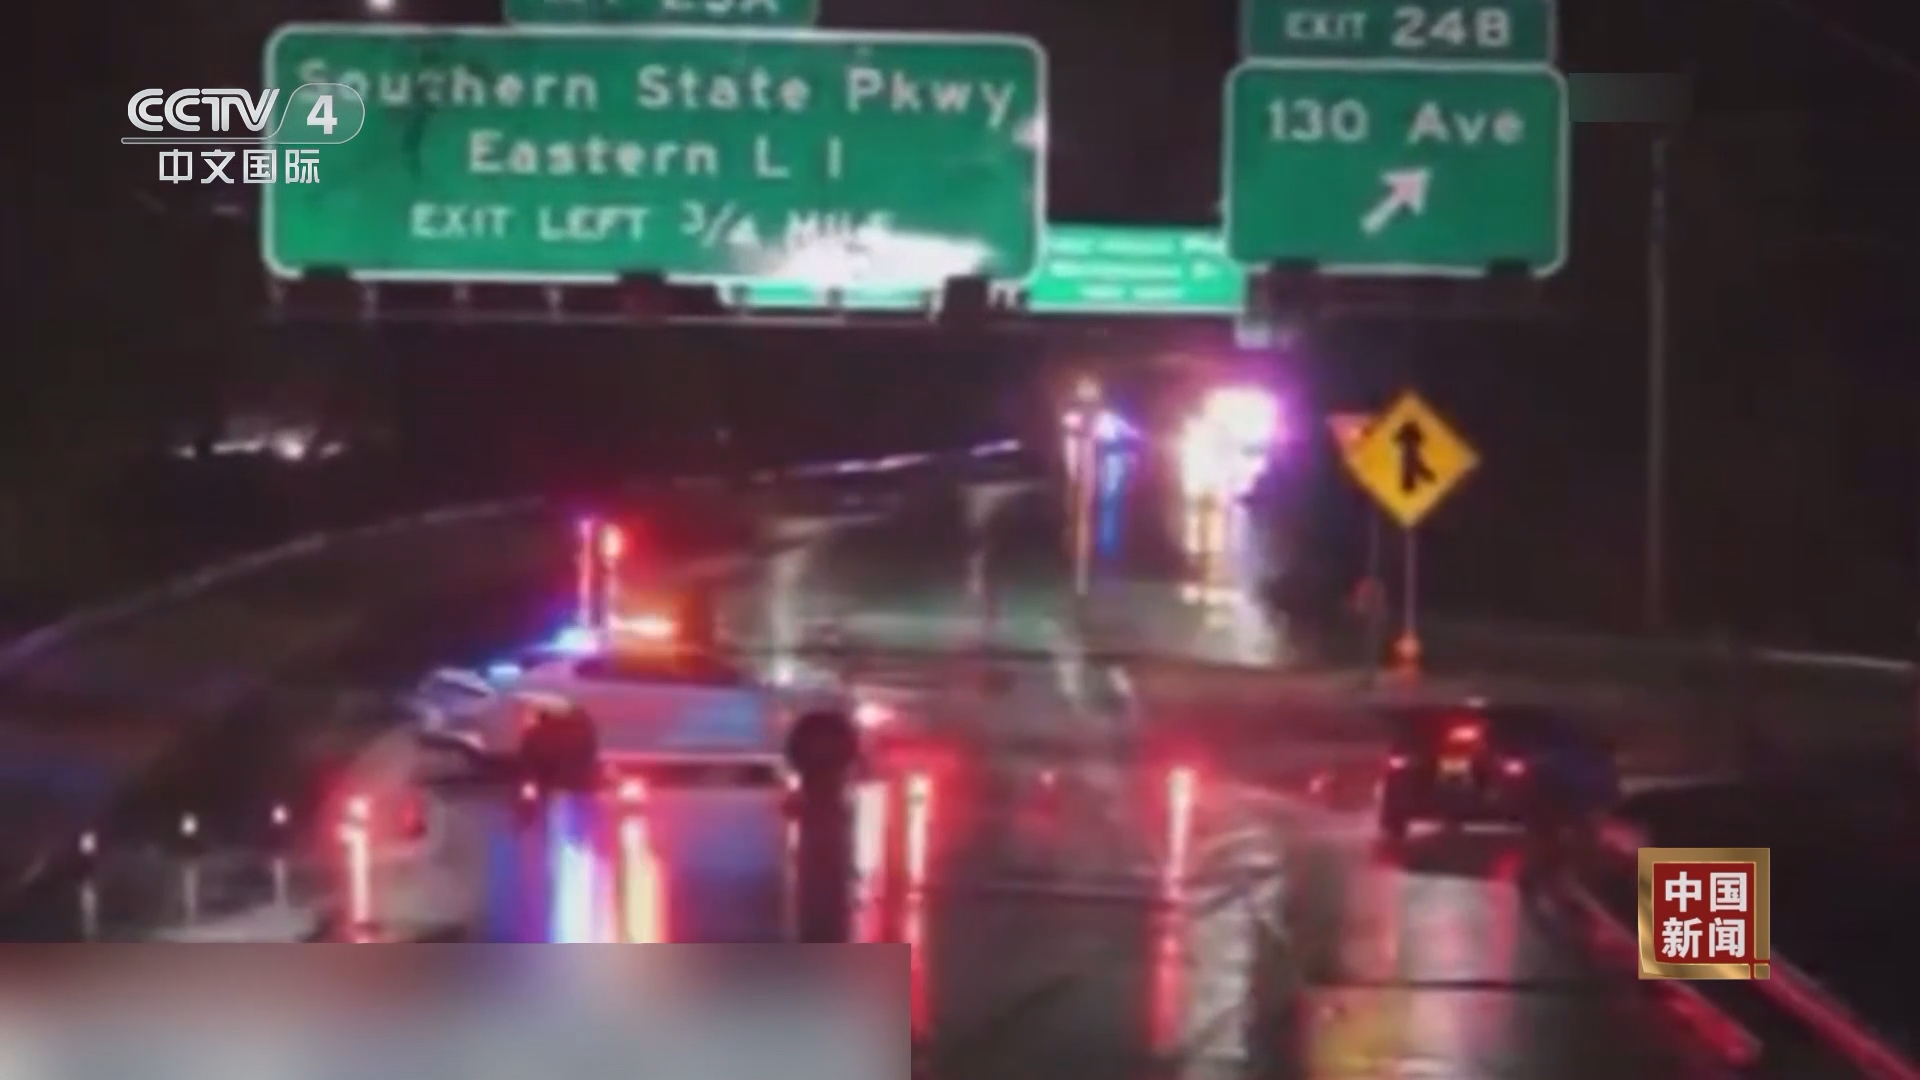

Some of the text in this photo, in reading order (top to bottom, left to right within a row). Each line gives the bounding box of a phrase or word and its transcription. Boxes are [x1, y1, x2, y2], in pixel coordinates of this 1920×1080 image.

[1284, 8, 1512, 48] EXIT 24B
[298, 58, 1017, 128] Southern State Pkwy
[1267, 100, 1526, 144] 130 Ave
[468, 130, 718, 177] Eastern
[754, 134, 789, 179] L
[409, 202, 515, 240] EXIT
[536, 203, 650, 243] LEFT
